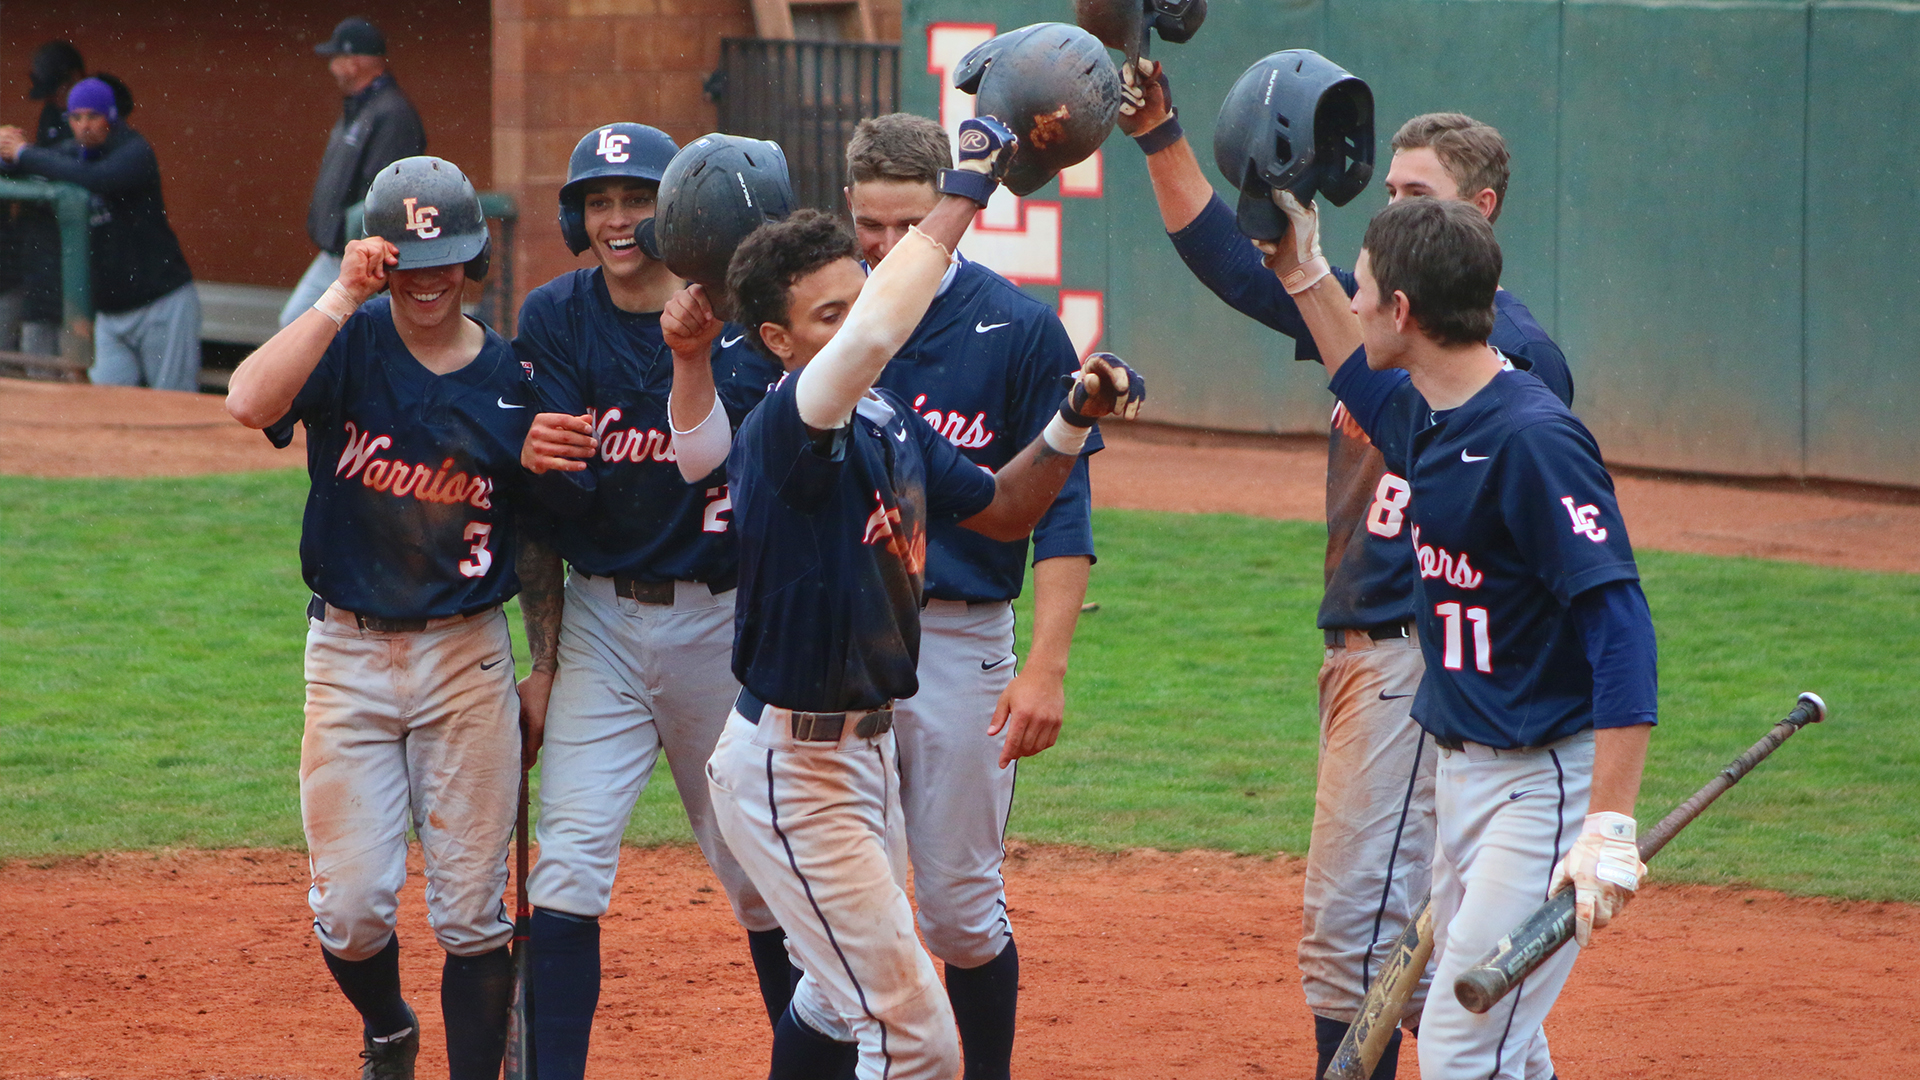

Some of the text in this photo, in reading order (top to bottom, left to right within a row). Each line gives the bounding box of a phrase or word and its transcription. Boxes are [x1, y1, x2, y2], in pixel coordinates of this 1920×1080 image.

[596, 128, 630, 163] LC
[403, 197, 441, 239] LC
[702, 484, 733, 533] 2
[1366, 470, 1411, 539] 8
[1560, 495, 1608, 543] LC
[458, 520, 493, 578] 3
[1434, 600, 1493, 673] 11
